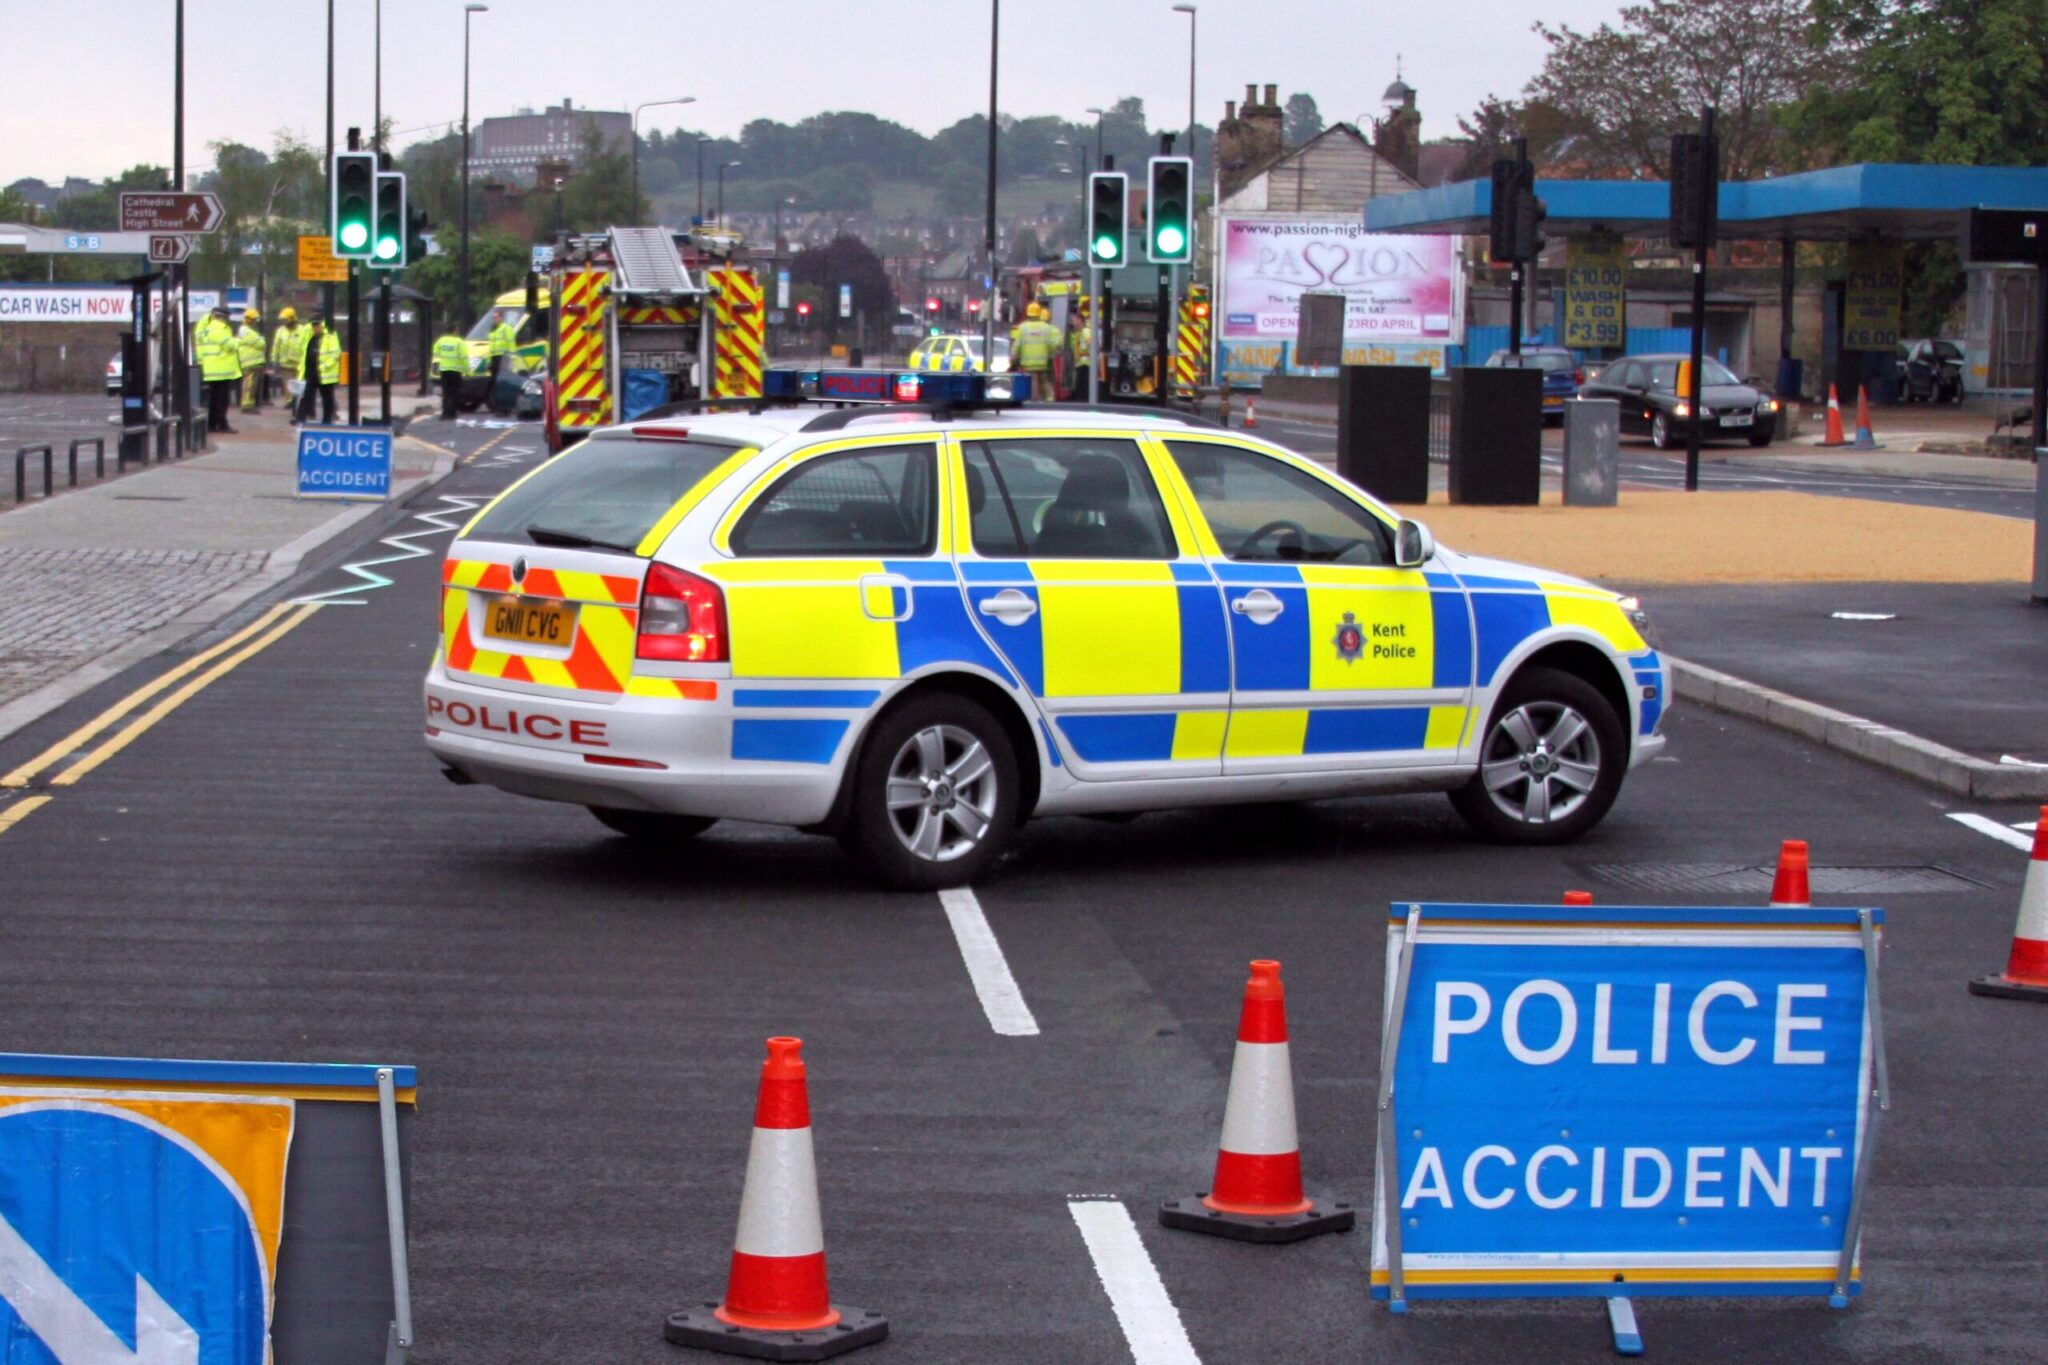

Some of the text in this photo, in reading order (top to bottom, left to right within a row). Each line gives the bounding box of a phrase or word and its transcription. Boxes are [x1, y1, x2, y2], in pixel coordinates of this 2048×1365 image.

[125, 197, 175, 207] Cathedral
[125, 208, 158, 218] Castle
[125, 219, 184, 230] High Street
[0, 298, 32, 314] CAR
[35, 298, 82, 314] WASH
[87, 298, 125, 314] NOW
[1347, 319, 1378, 329] 23RD
[1381, 320, 1417, 330] APRIL
[1569, 323, 1619, 341] £3.99
[303, 438, 384, 458] POLICE
[300, 470, 388, 487] ACCIDENT
[527, 609, 560, 640] CVG
[1372, 623, 1405, 637] Kent
[1373, 644, 1416, 659] Police
[427, 695, 609, 747] POLICE
[1431, 979, 1828, 1065] POLICE
[1400, 1145, 1843, 1210] ACCIDENT
